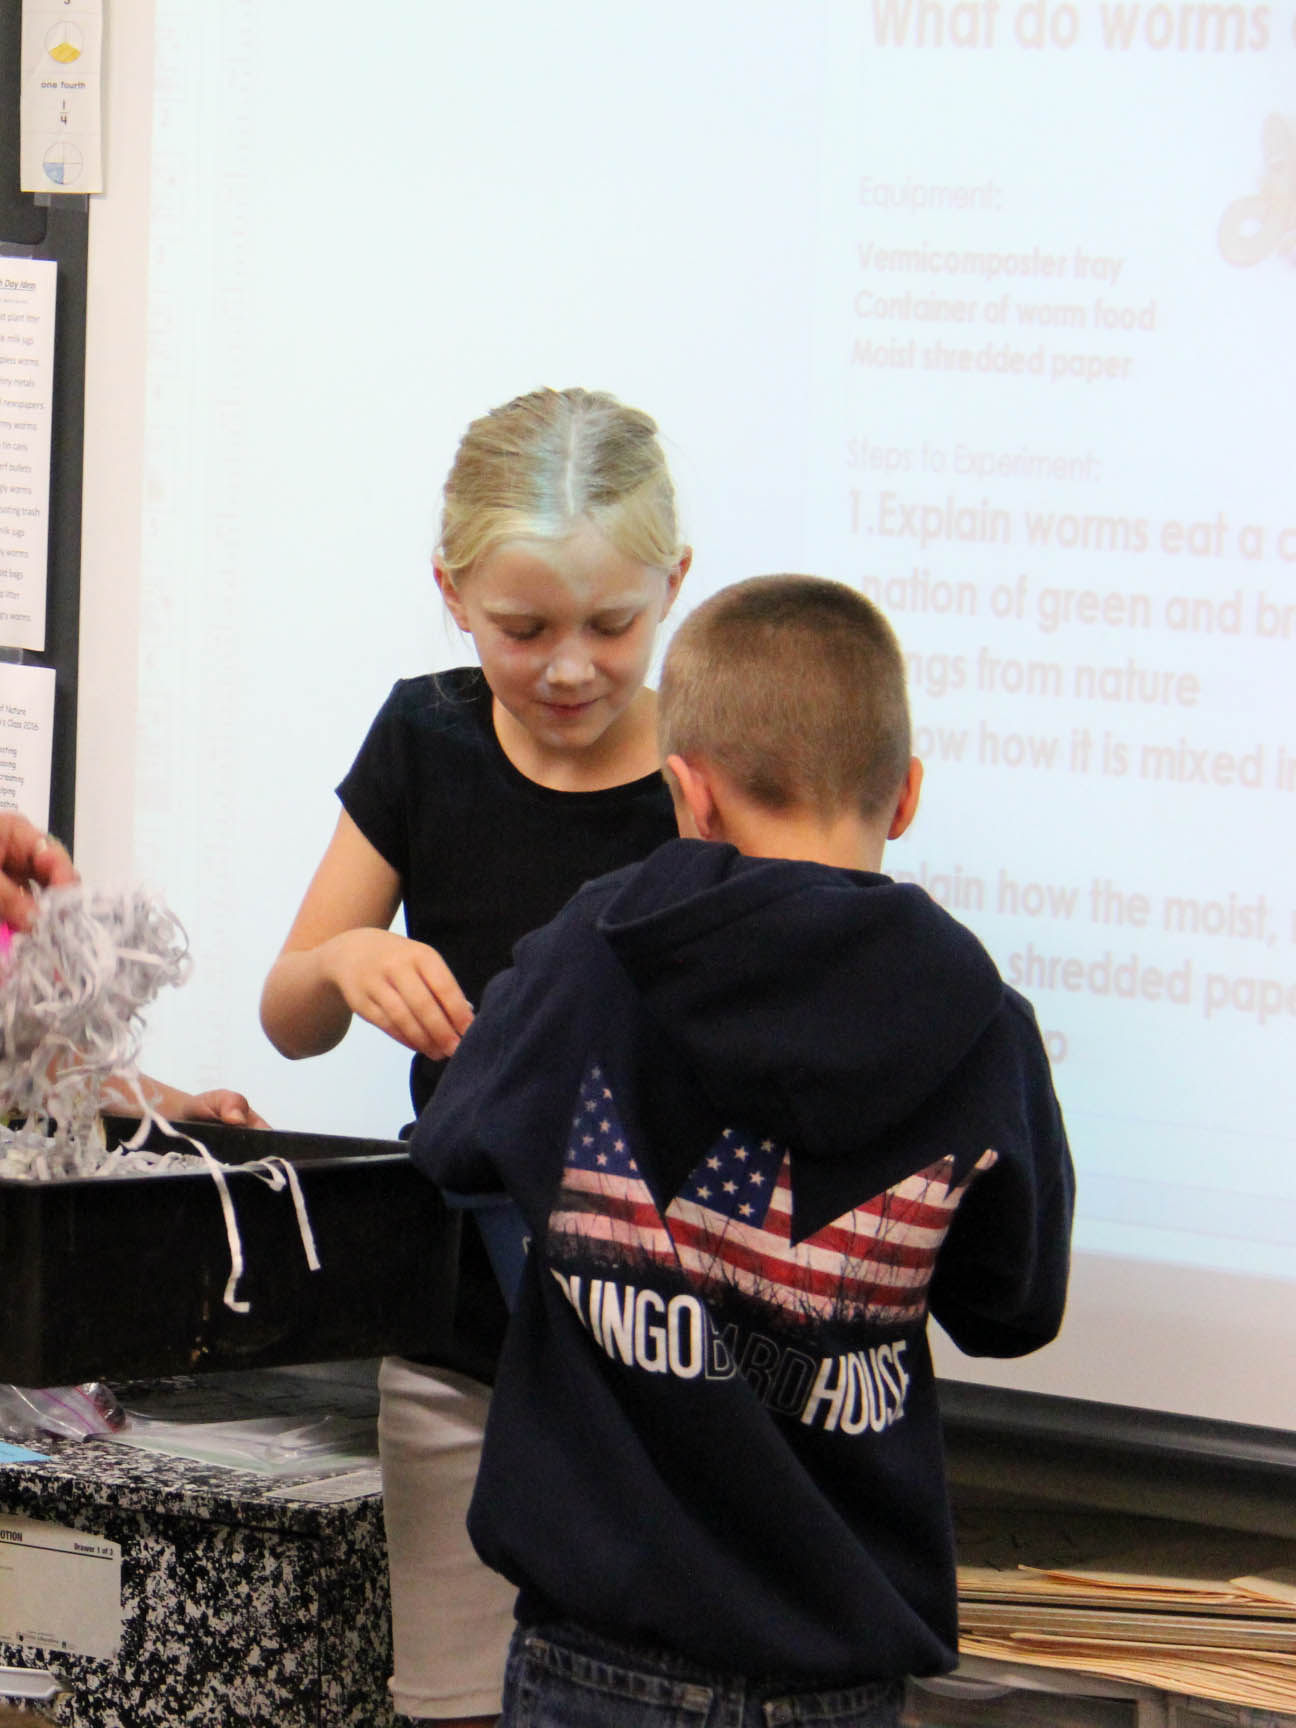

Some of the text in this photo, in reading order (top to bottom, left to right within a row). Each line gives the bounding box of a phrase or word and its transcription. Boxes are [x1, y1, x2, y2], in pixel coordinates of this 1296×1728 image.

[872, 0, 1001, 49] What
[1013, 0, 1081, 50] do
[1098, 0, 1272, 52] worms
[40, 80, 86, 89] one fourth
[853, 289, 1158, 331] Container of worm food
[850, 336, 1137, 383] Moist shredded paper
[1023, 510, 1148, 553] worms
[1160, 512, 1228, 557] eat
[1237, 524, 1264, 561] a
[861, 568, 977, 617] nation
[990, 574, 1029, 619] of
[1037, 586, 1150, 633] green
[1164, 590, 1243, 635] and
[977, 645, 1063, 697] from
[1074, 657, 1201, 707] nature
[979, 720, 1059, 768] how
[1070, 727, 1091, 773] it
[1104, 730, 1129, 776] is
[1141, 736, 1262, 789] mixed
[997, 868, 1078, 920] how
[1089, 876, 1150, 928] the
[1163, 890, 1277, 948] moist,
[1007, 942, 1191, 1006] shredded
